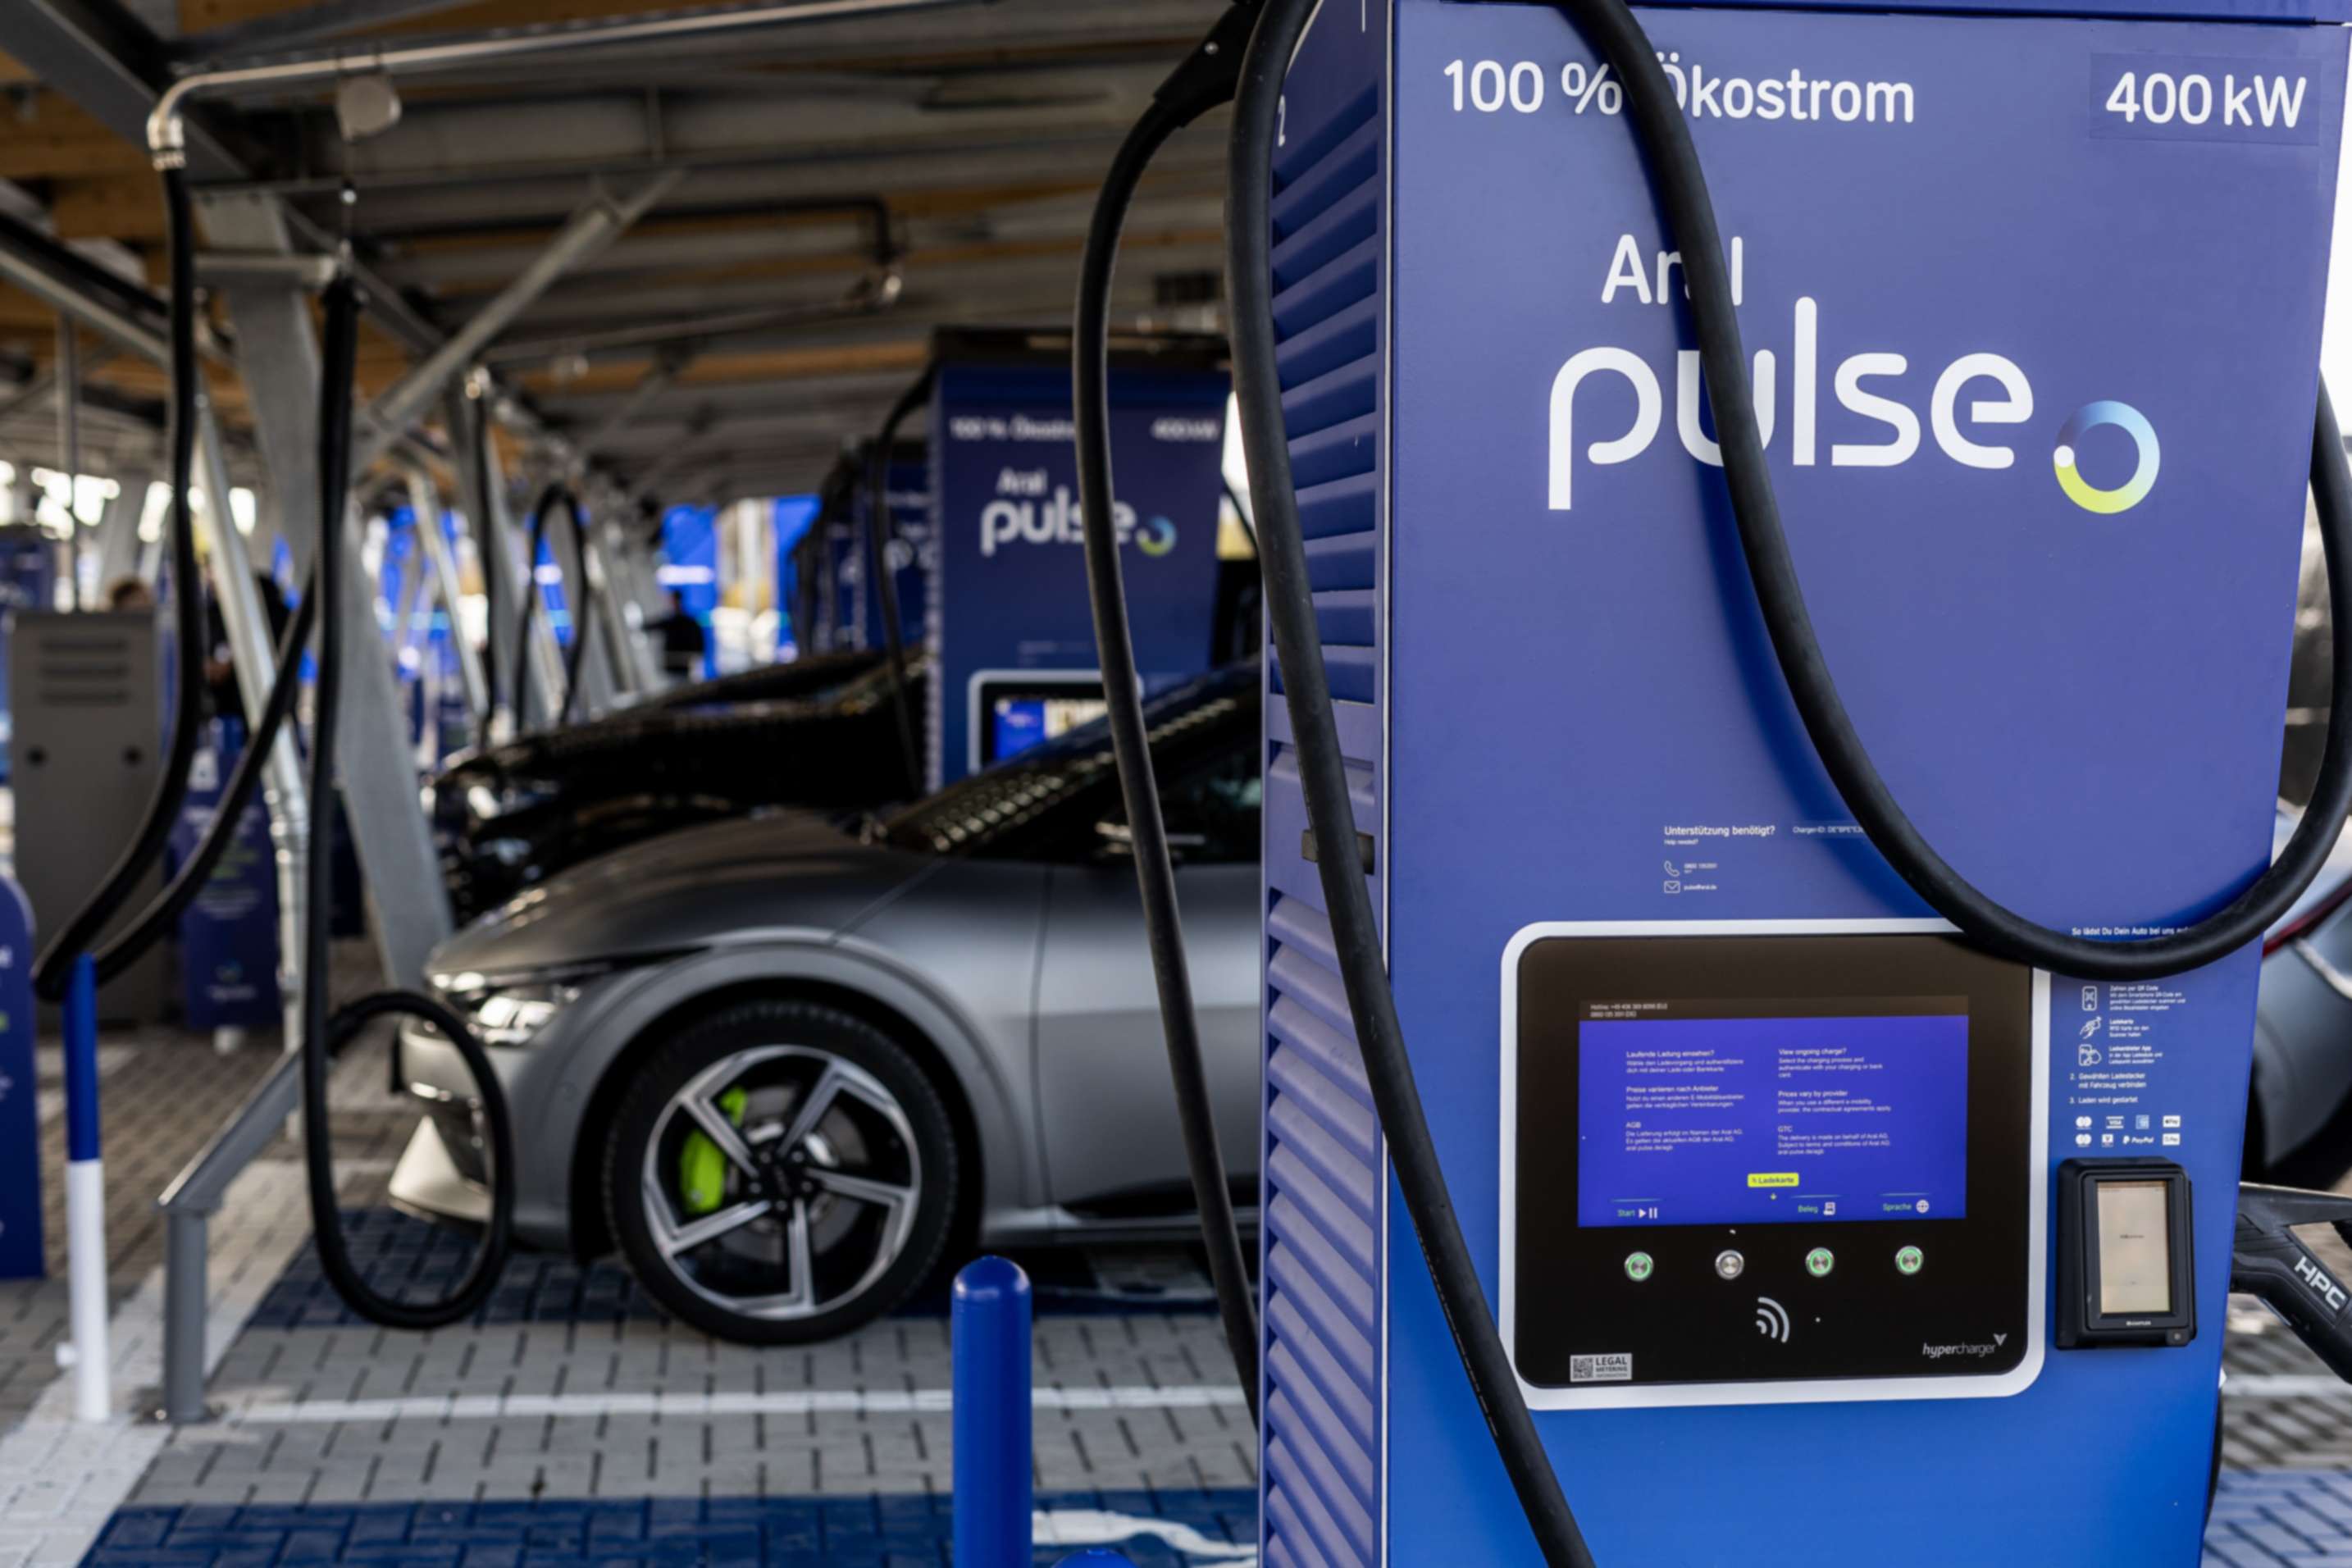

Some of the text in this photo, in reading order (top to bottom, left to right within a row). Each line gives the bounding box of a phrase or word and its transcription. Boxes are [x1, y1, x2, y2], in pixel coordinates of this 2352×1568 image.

[1443, 59, 1544, 113] 100
[1561, 62, 1620, 115] %
[2105, 71, 2307, 128] 400 kW
[1601, 234, 1743, 306] Arl
[1548, 294, 2034, 510] pulse
[996, 467, 1048, 495] Aral
[1664, 825, 1775, 837] Unterstützung benötigt?
[2072, 927, 2081, 935] So
[2102, 927, 2112, 935] Du
[2114, 927, 2130, 935] Dein
[2131, 927, 2147, 935] Auto
[2149, 927, 2159, 935] bei
[2162, 927, 2175, 935] uns
[1757, 1176, 1794, 1184] Ladekarte
[1617, 1209, 1635, 1218] Start
[1798, 1205, 1818, 1214] Beleg
[1882, 1202, 1912, 1212] Sprache
[2294, 1256, 2348, 1310] HPC
[1922, 1342, 1996, 1358] hypercharger
[1595, 1356, 1627, 1365] LEGAL
